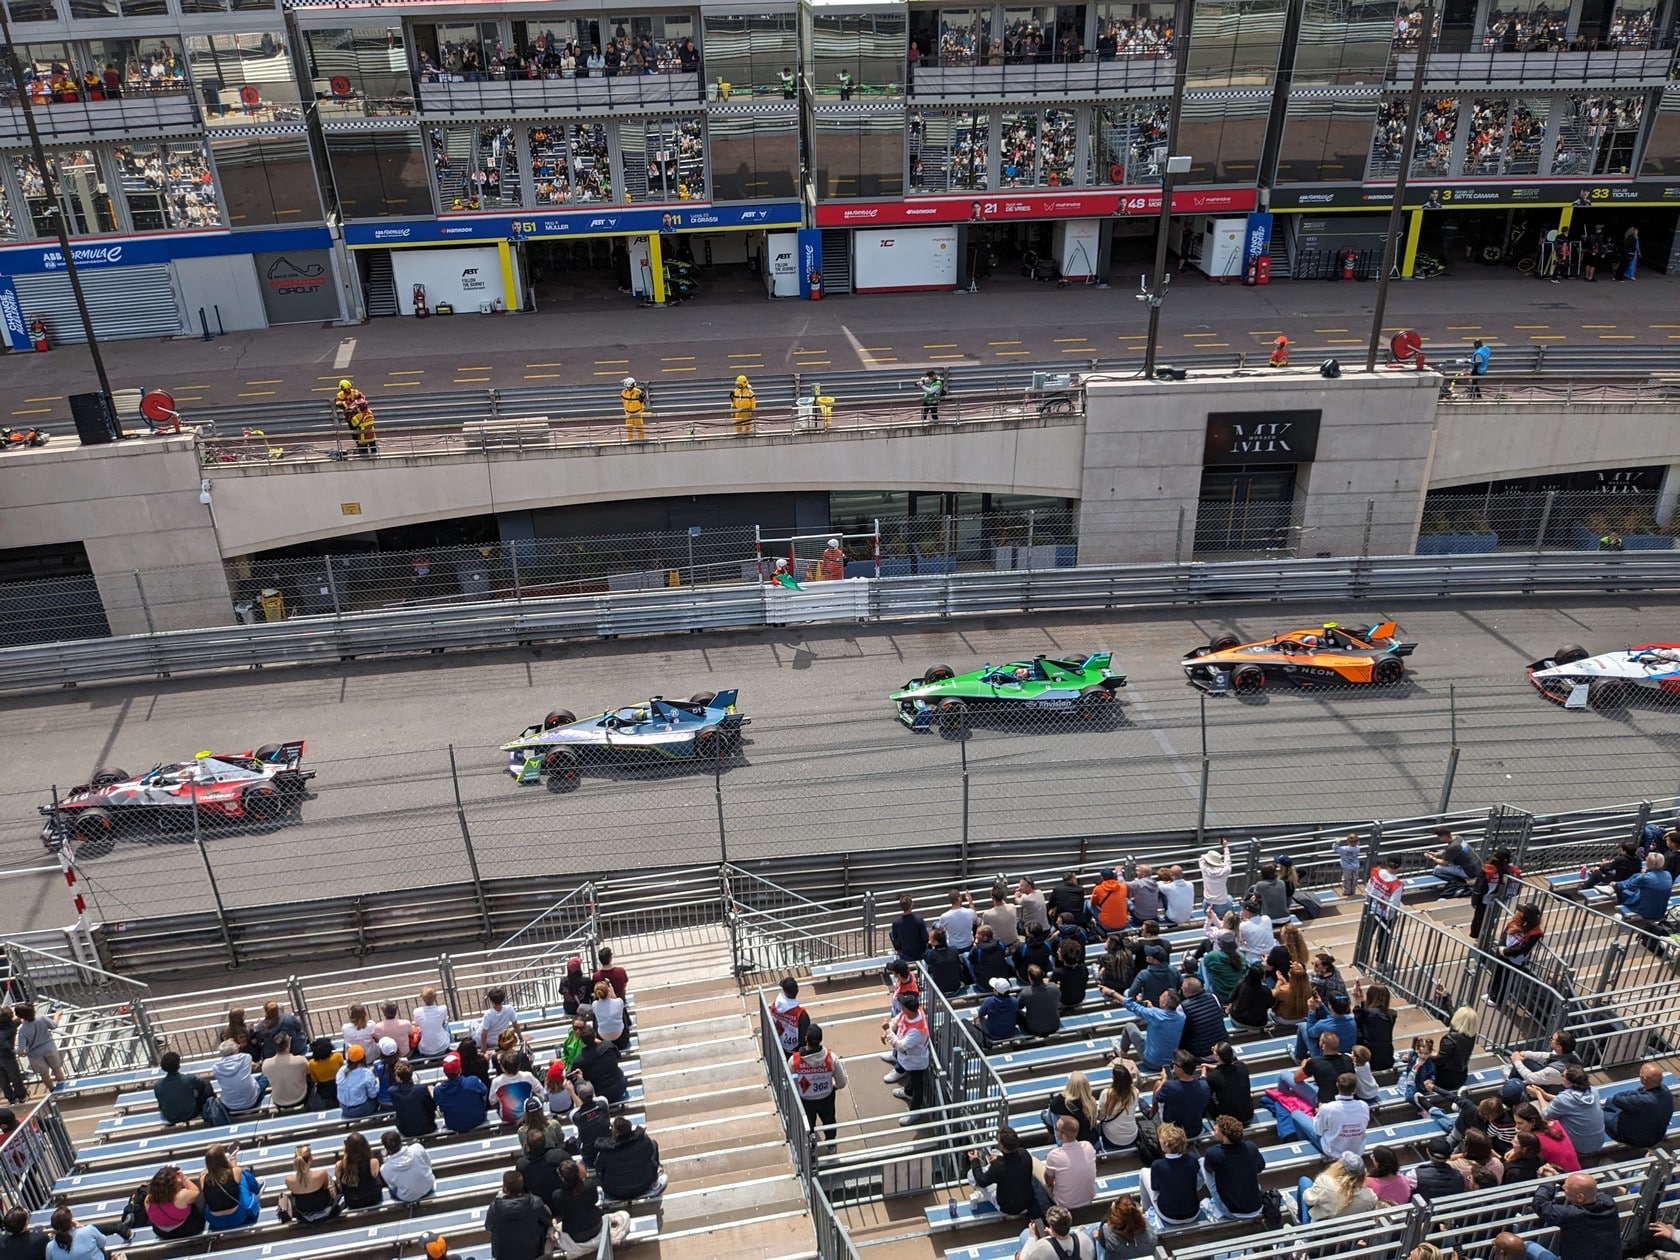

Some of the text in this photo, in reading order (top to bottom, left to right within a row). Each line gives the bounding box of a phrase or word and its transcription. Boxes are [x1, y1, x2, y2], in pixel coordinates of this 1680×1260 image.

[1442, 190, 1452, 201] 3
[1592, 189, 1610, 199] 33
[984, 203, 998, 214] 21
[1128, 199, 1146, 209] 48
[672, 215, 682, 225] 11
[523, 222, 536, 232] 51
[43, 253, 62, 262] ABB
[776, 253, 793, 262] ABT
[462, 268, 479, 277] ABT
[278, 285, 320, 295] CIRCUIT
[1, 294, 17, 331] CHANGE
[1230, 423, 1293, 453] MK
[1248, 435, 1276, 444] MONACO
[1301, 667, 1335, 677] NEOM
[812, 1082, 829, 1092] 362
